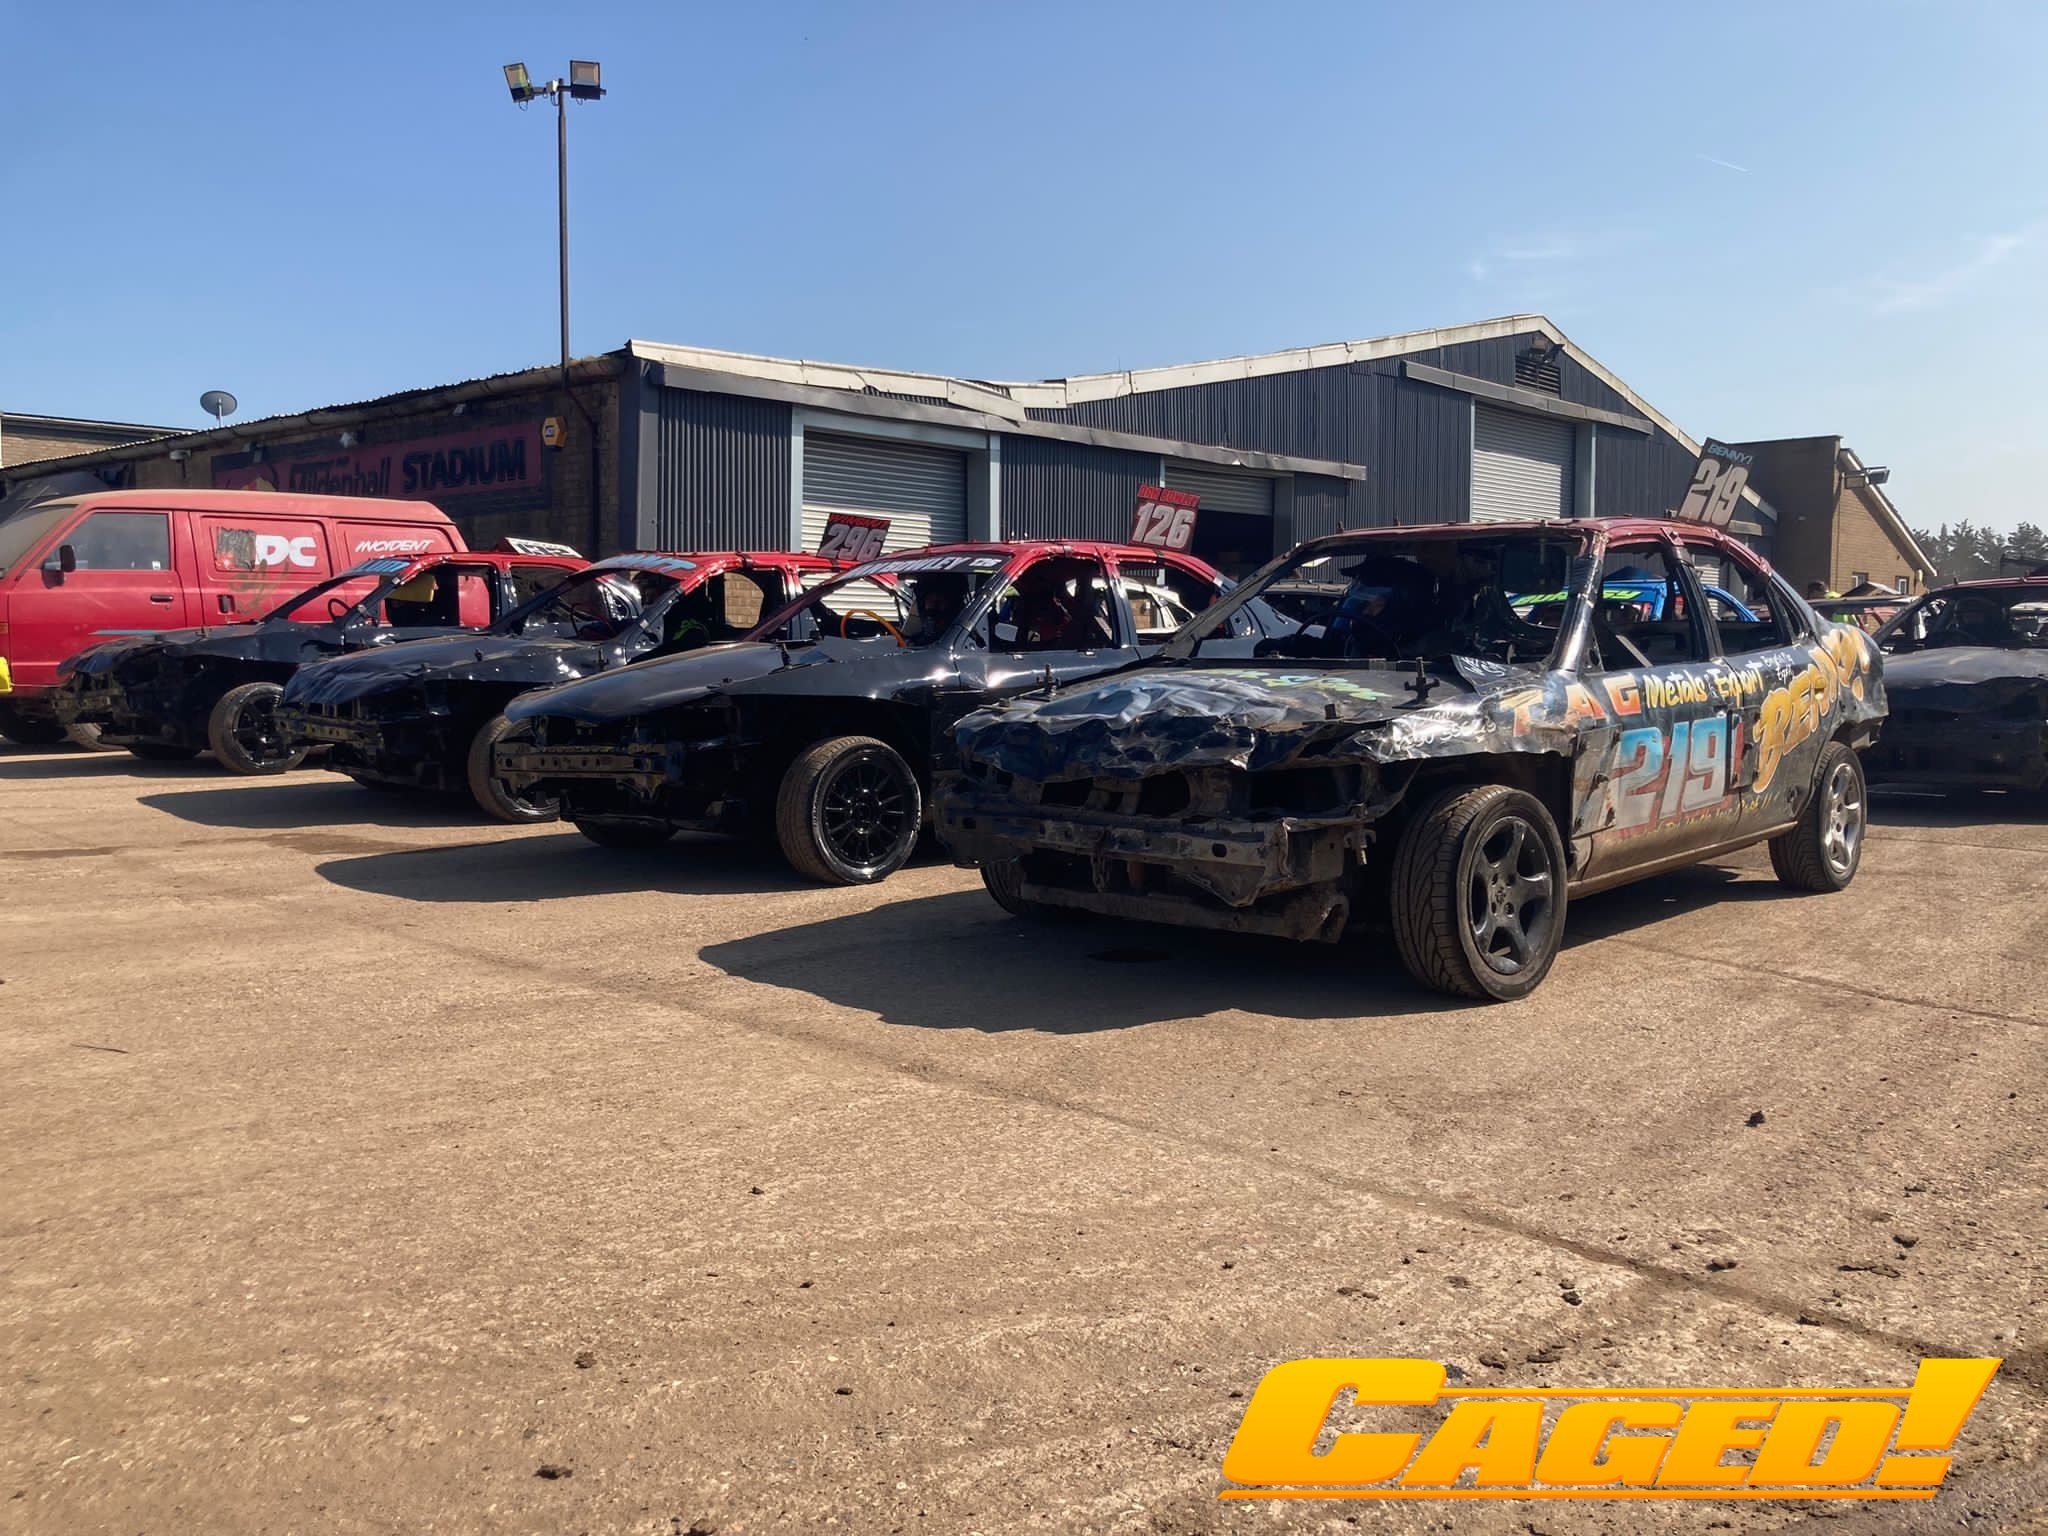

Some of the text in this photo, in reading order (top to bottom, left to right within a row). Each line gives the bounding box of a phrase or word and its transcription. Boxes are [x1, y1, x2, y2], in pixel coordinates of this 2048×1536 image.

[403, 438, 526, 492] STADIUM
[1679, 458, 1748, 525] 219
[355, 540, 435, 552] INCIDENT
[820, 523, 887, 562] 296
[1132, 502, 1195, 548] 126
[1643, 670, 1707, 708] Metals
[1613, 715, 1728, 829] 219
